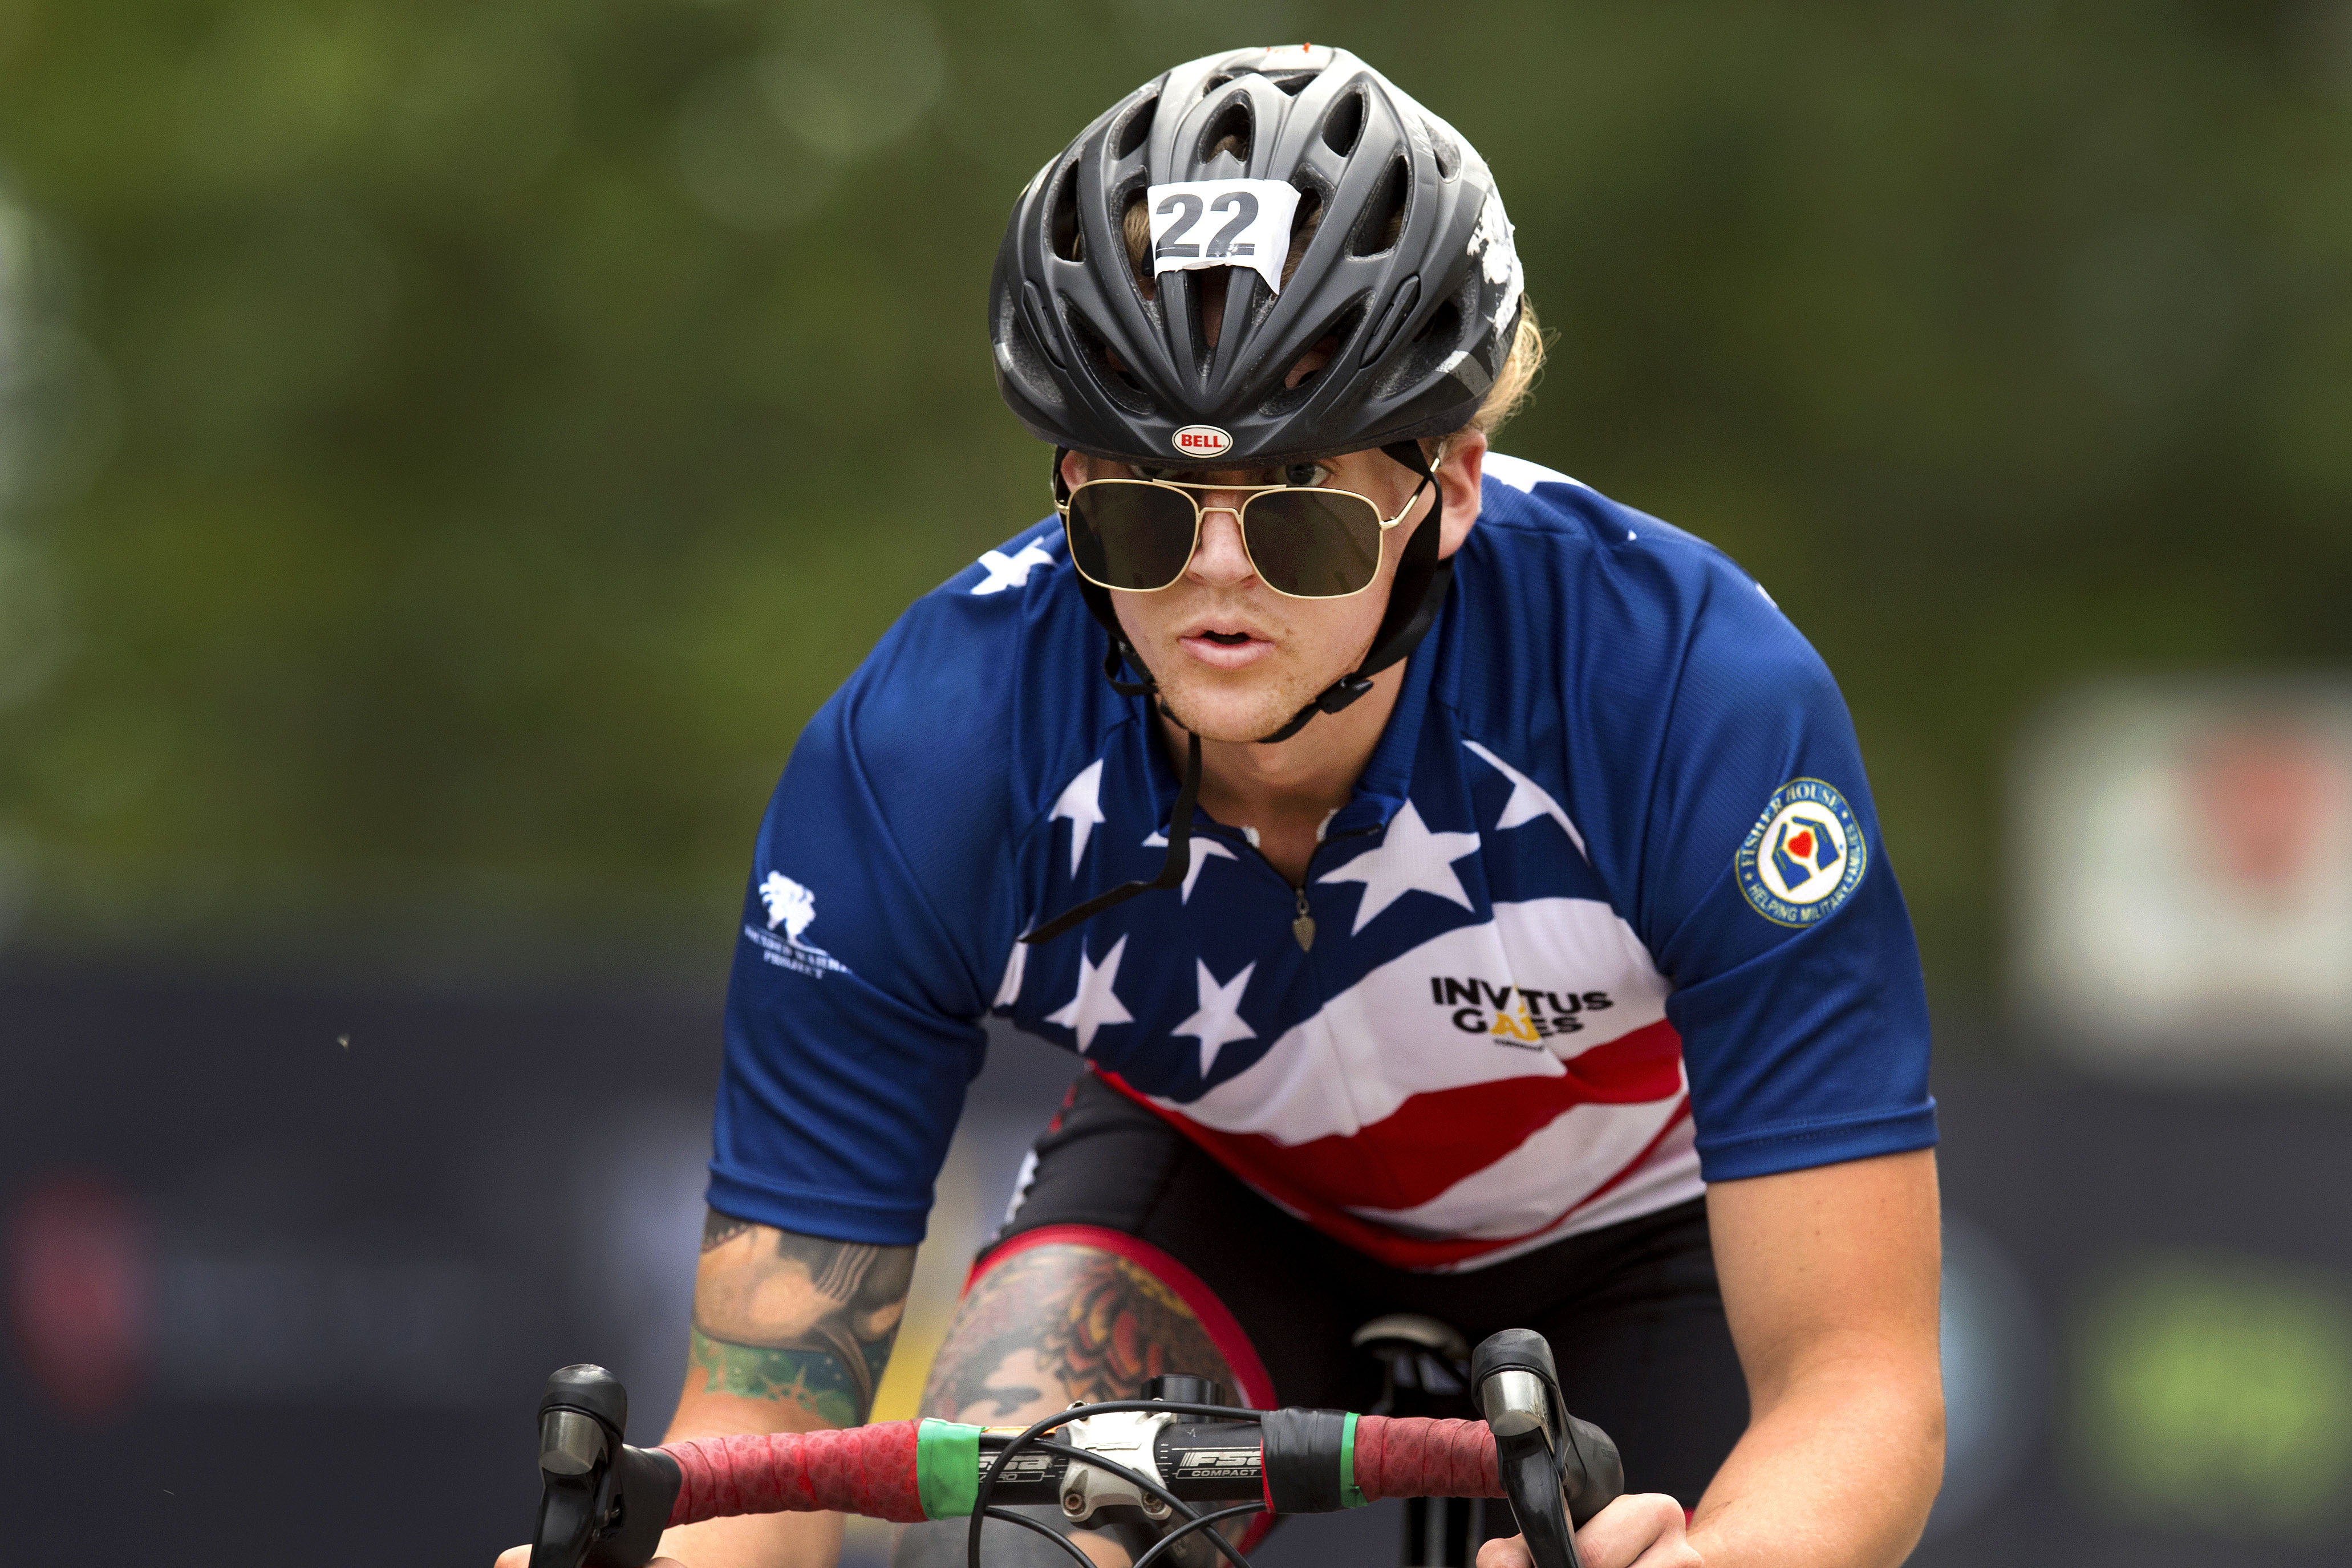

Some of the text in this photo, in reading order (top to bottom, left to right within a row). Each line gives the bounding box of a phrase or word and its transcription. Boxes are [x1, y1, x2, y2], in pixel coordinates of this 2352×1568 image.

[1155, 191, 1259, 259] 22
[1181, 434, 1222, 448] BELL
[1748, 883, 1798, 922] HELPING
[1430, 977, 1614, 1015] INVTUS
